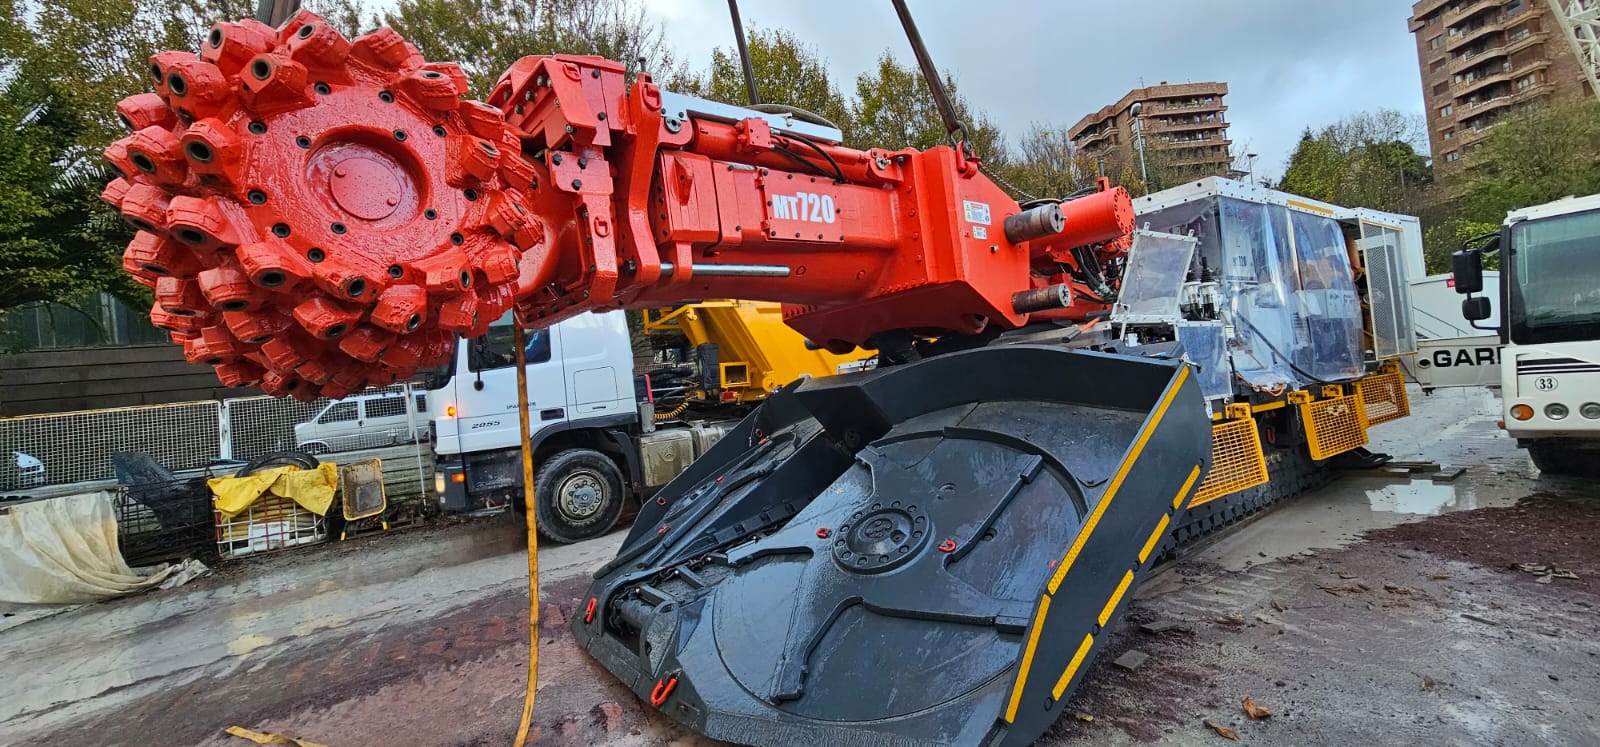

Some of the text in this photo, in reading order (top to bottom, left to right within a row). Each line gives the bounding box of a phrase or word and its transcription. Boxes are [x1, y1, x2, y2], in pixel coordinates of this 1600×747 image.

[772, 191, 835, 224] MT720
[1539, 378, 1553, 390] 33
[471, 421, 500, 429] 2055
